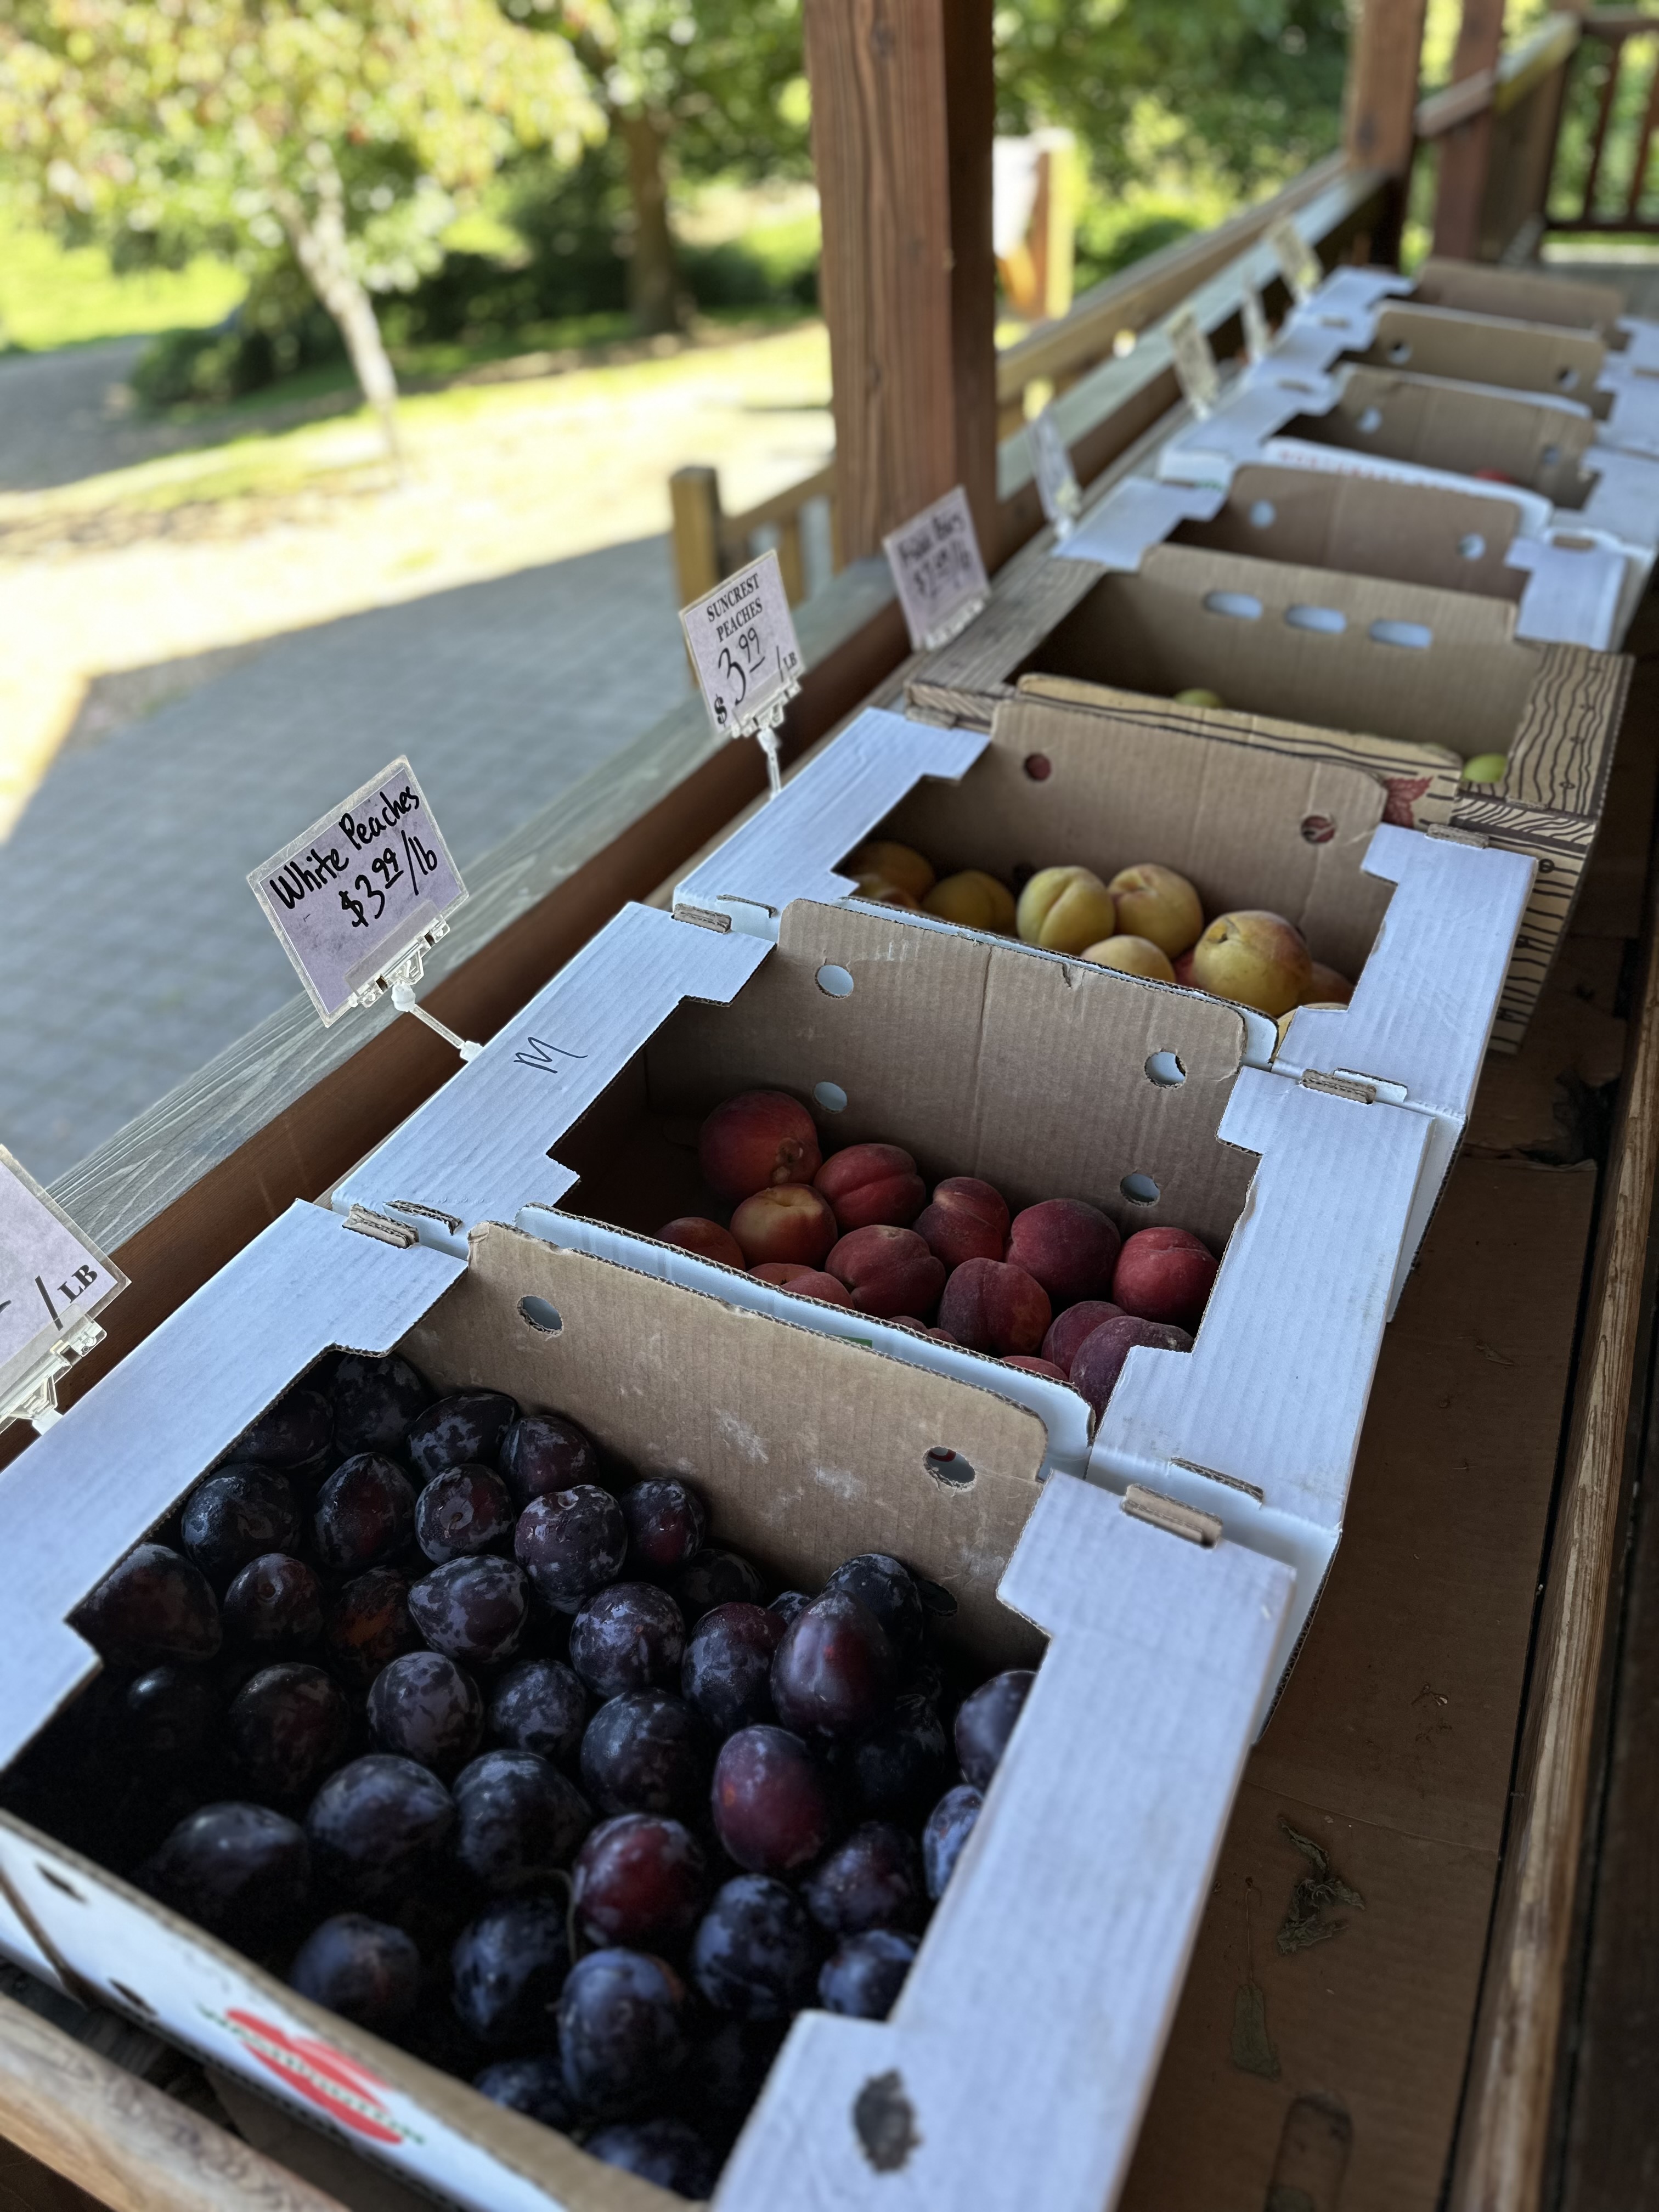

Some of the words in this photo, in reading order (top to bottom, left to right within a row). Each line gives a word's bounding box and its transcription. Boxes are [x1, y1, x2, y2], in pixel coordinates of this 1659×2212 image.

[706, 573, 760, 623] SUNCREST
[716, 597, 763, 643] PEACHES
[269, 848, 349, 909] White
[338, 786, 420, 850] Peaches
